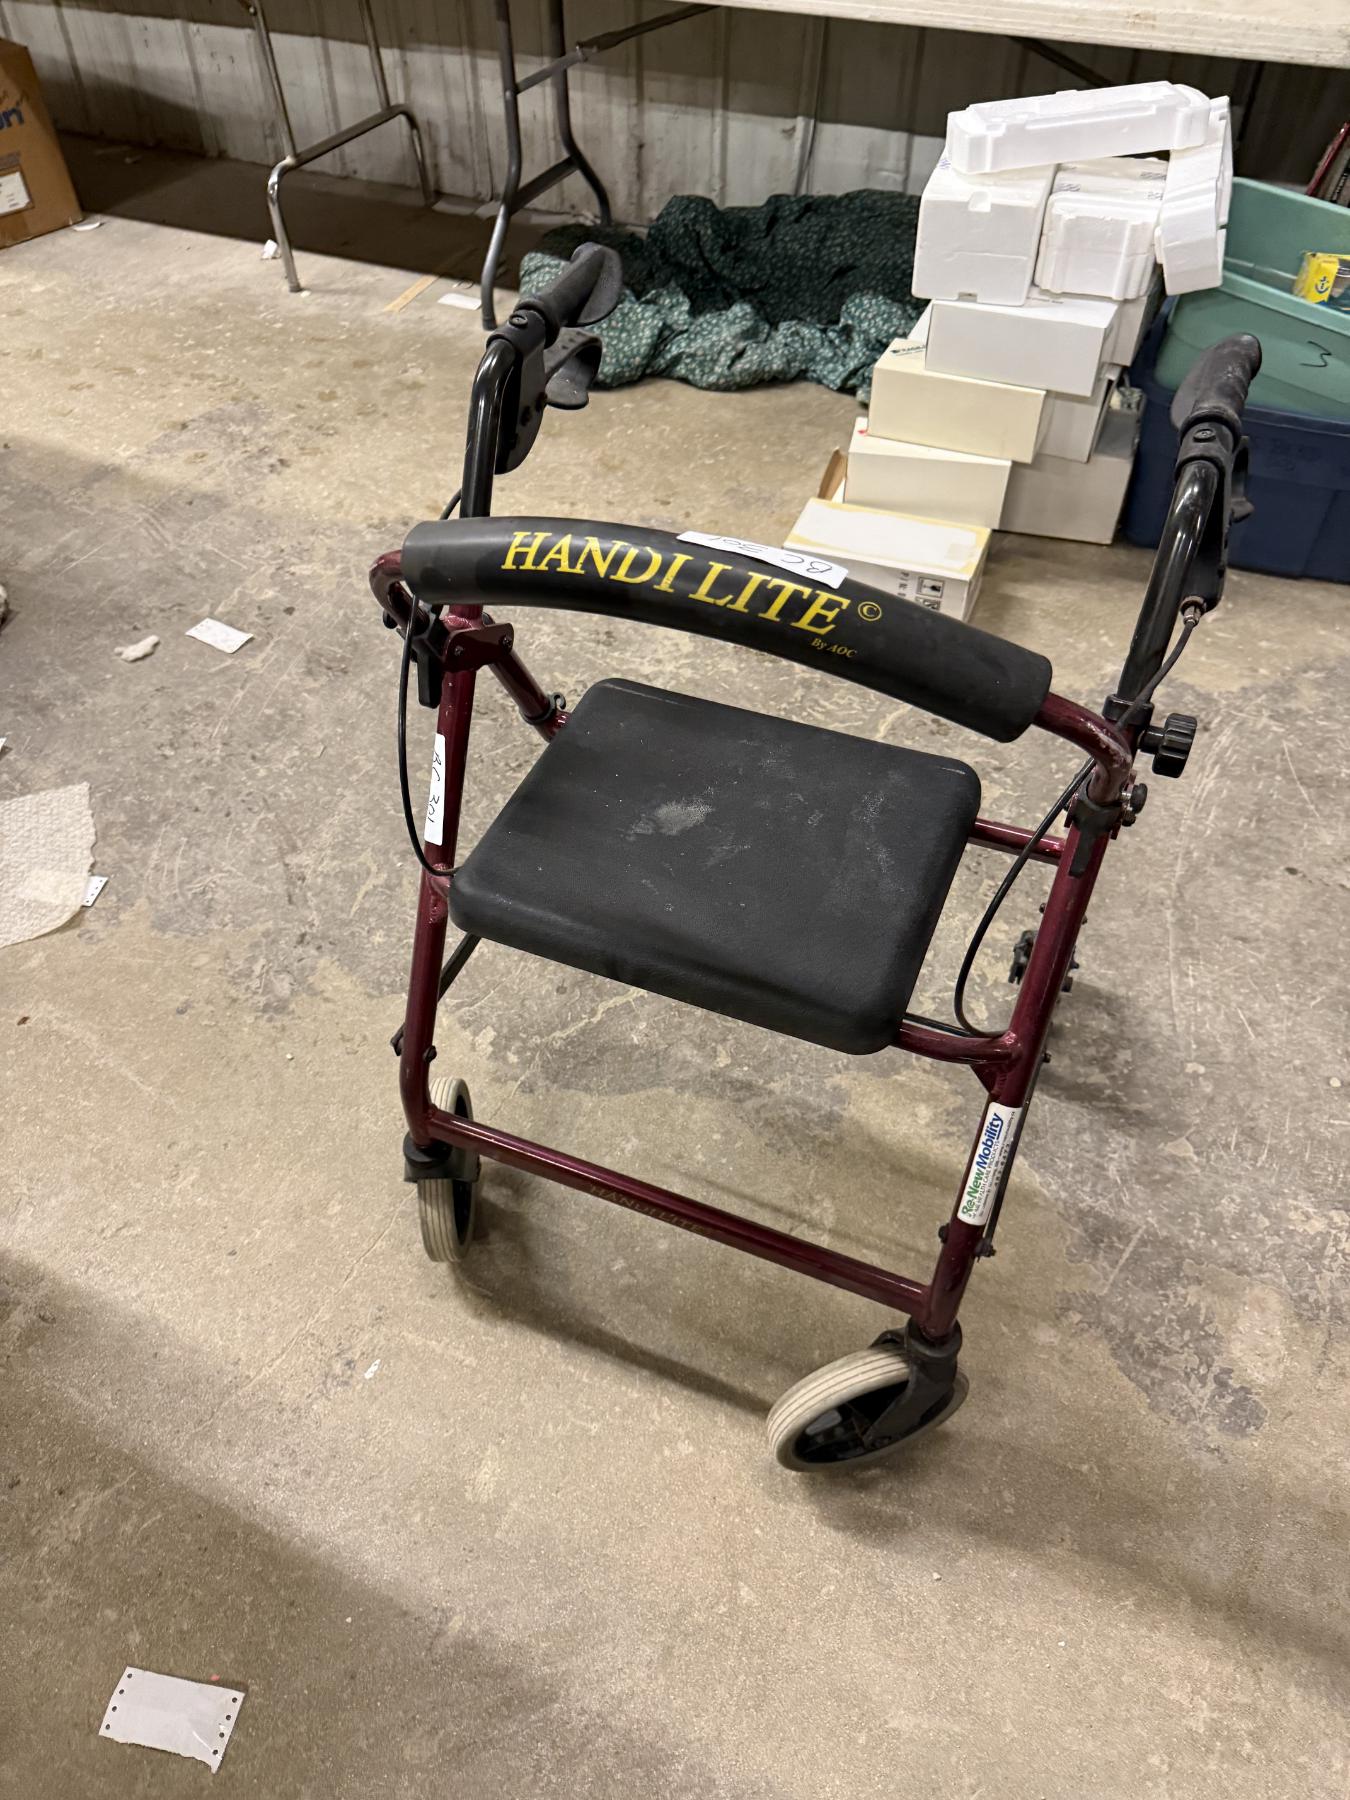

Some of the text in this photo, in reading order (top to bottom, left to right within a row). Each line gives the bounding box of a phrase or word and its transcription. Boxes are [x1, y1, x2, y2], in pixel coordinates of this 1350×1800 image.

[780, 553, 832, 574] BC
[811, 638, 858, 658] By AOC
[986, 1139, 1000, 1169] PRODUCTS
